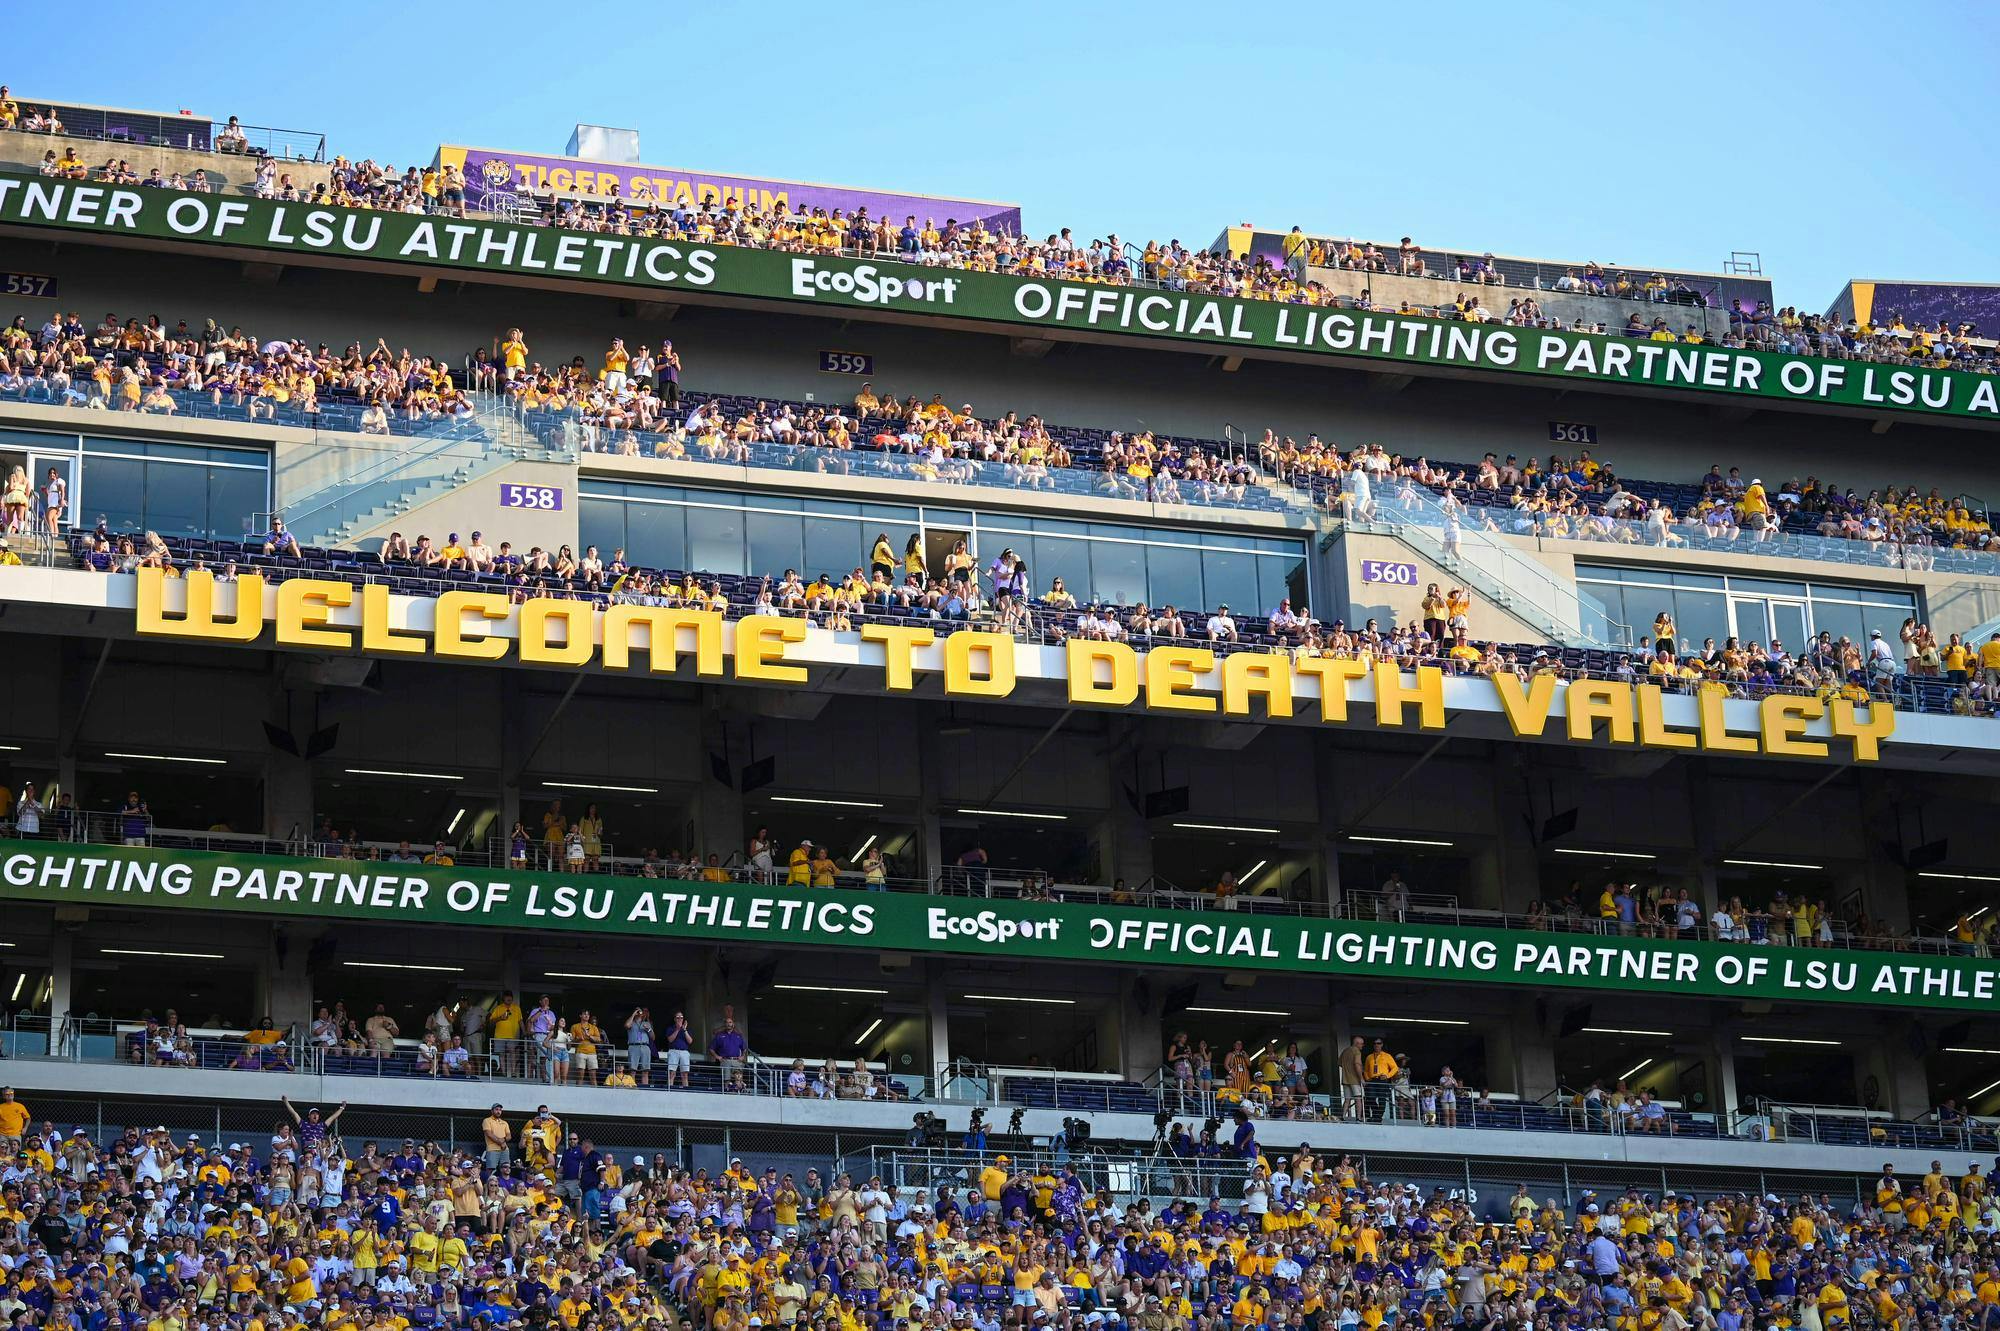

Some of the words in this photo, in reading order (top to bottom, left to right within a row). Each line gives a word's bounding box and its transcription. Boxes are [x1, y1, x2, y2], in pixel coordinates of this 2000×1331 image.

[514, 163, 620, 197] TIGER
[166, 197, 249, 237] OF
[267, 207, 382, 251] LSU
[399, 222, 718, 285] ATHLETICS
[7, 274, 49, 296] 557
[1014, 282, 1253, 340] OFFICIAL
[1275, 308, 1518, 365] LIGHTING
[1537, 335, 1762, 390] PARTNER
[1780, 361, 1845, 396] OF
[1863, 368, 1951, 408] LSU
[1967, 380, 1999, 413] A
[825, 352, 867, 376] 559
[1555, 422, 1591, 444] 561
[508, 484, 556, 511] 558
[1368, 562, 1412, 585] 560
[136, 566, 808, 684] WELCOME
[861, 623, 1016, 697] TO
[1067, 638, 1446, 730] DEATH
[1492, 672, 1895, 762] VALLEY
[3, 854, 193, 895] GHTING
[210, 866, 429, 909] PARTNER
[446, 880, 511, 913] OF
[525, 885, 614, 920] LSU
[626, 891, 875, 935] ATHLETICS
[1089, 918, 1279, 958] OFFICIAL
[1297, 930, 1497, 970] LIGHTING
[1513, 943, 1699, 982] PARTNER
[1715, 955, 1769, 985] OF
[1783, 959, 1857, 991] LSU
[1871, 965, 2000, 999] ATHLE
[381, 1200, 392, 1214] 9
